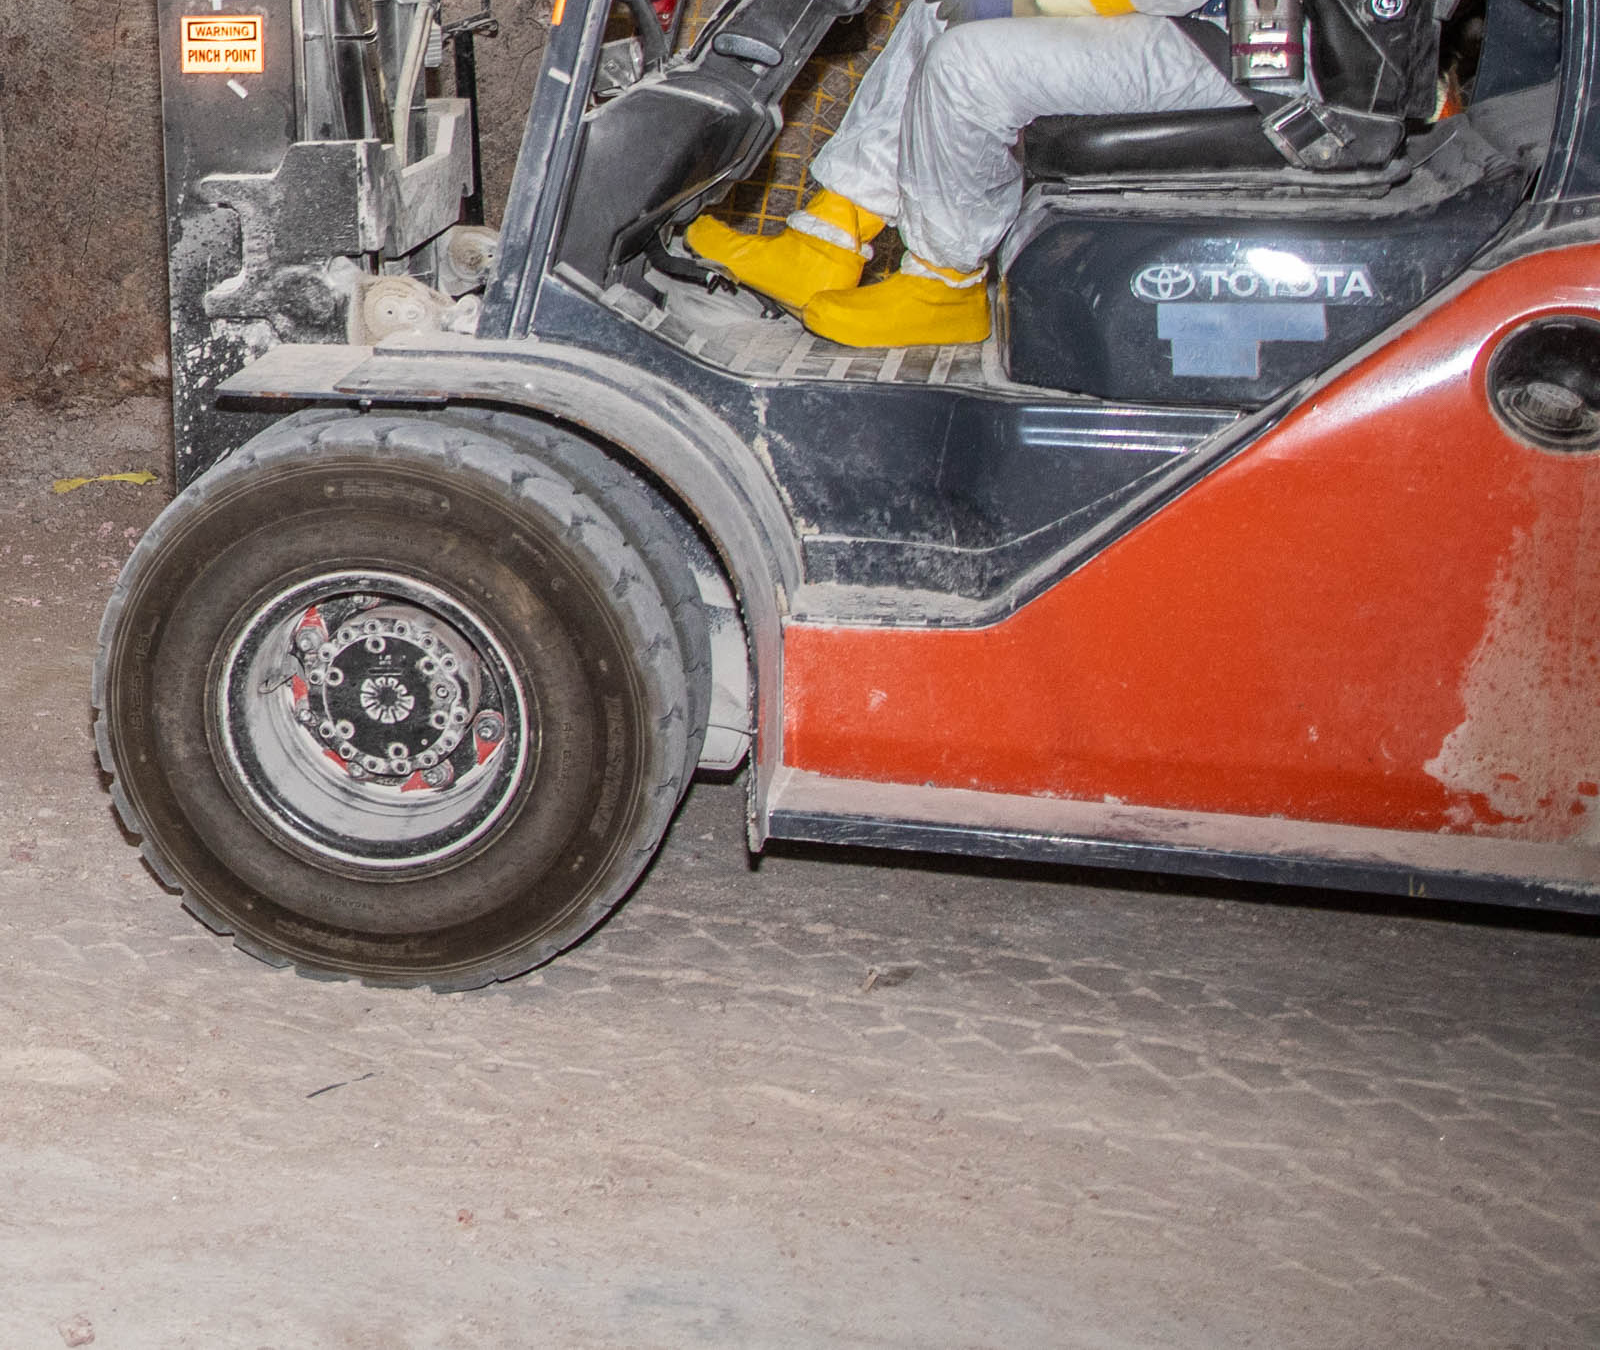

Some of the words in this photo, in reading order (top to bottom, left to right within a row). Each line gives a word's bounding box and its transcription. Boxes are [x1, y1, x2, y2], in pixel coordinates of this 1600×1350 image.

[194, 25, 250, 37] WARNING
[188, 49, 221, 63] PINCH
[225, 49, 257, 63] POINT
[1200, 269, 1374, 299] TOYOTA
